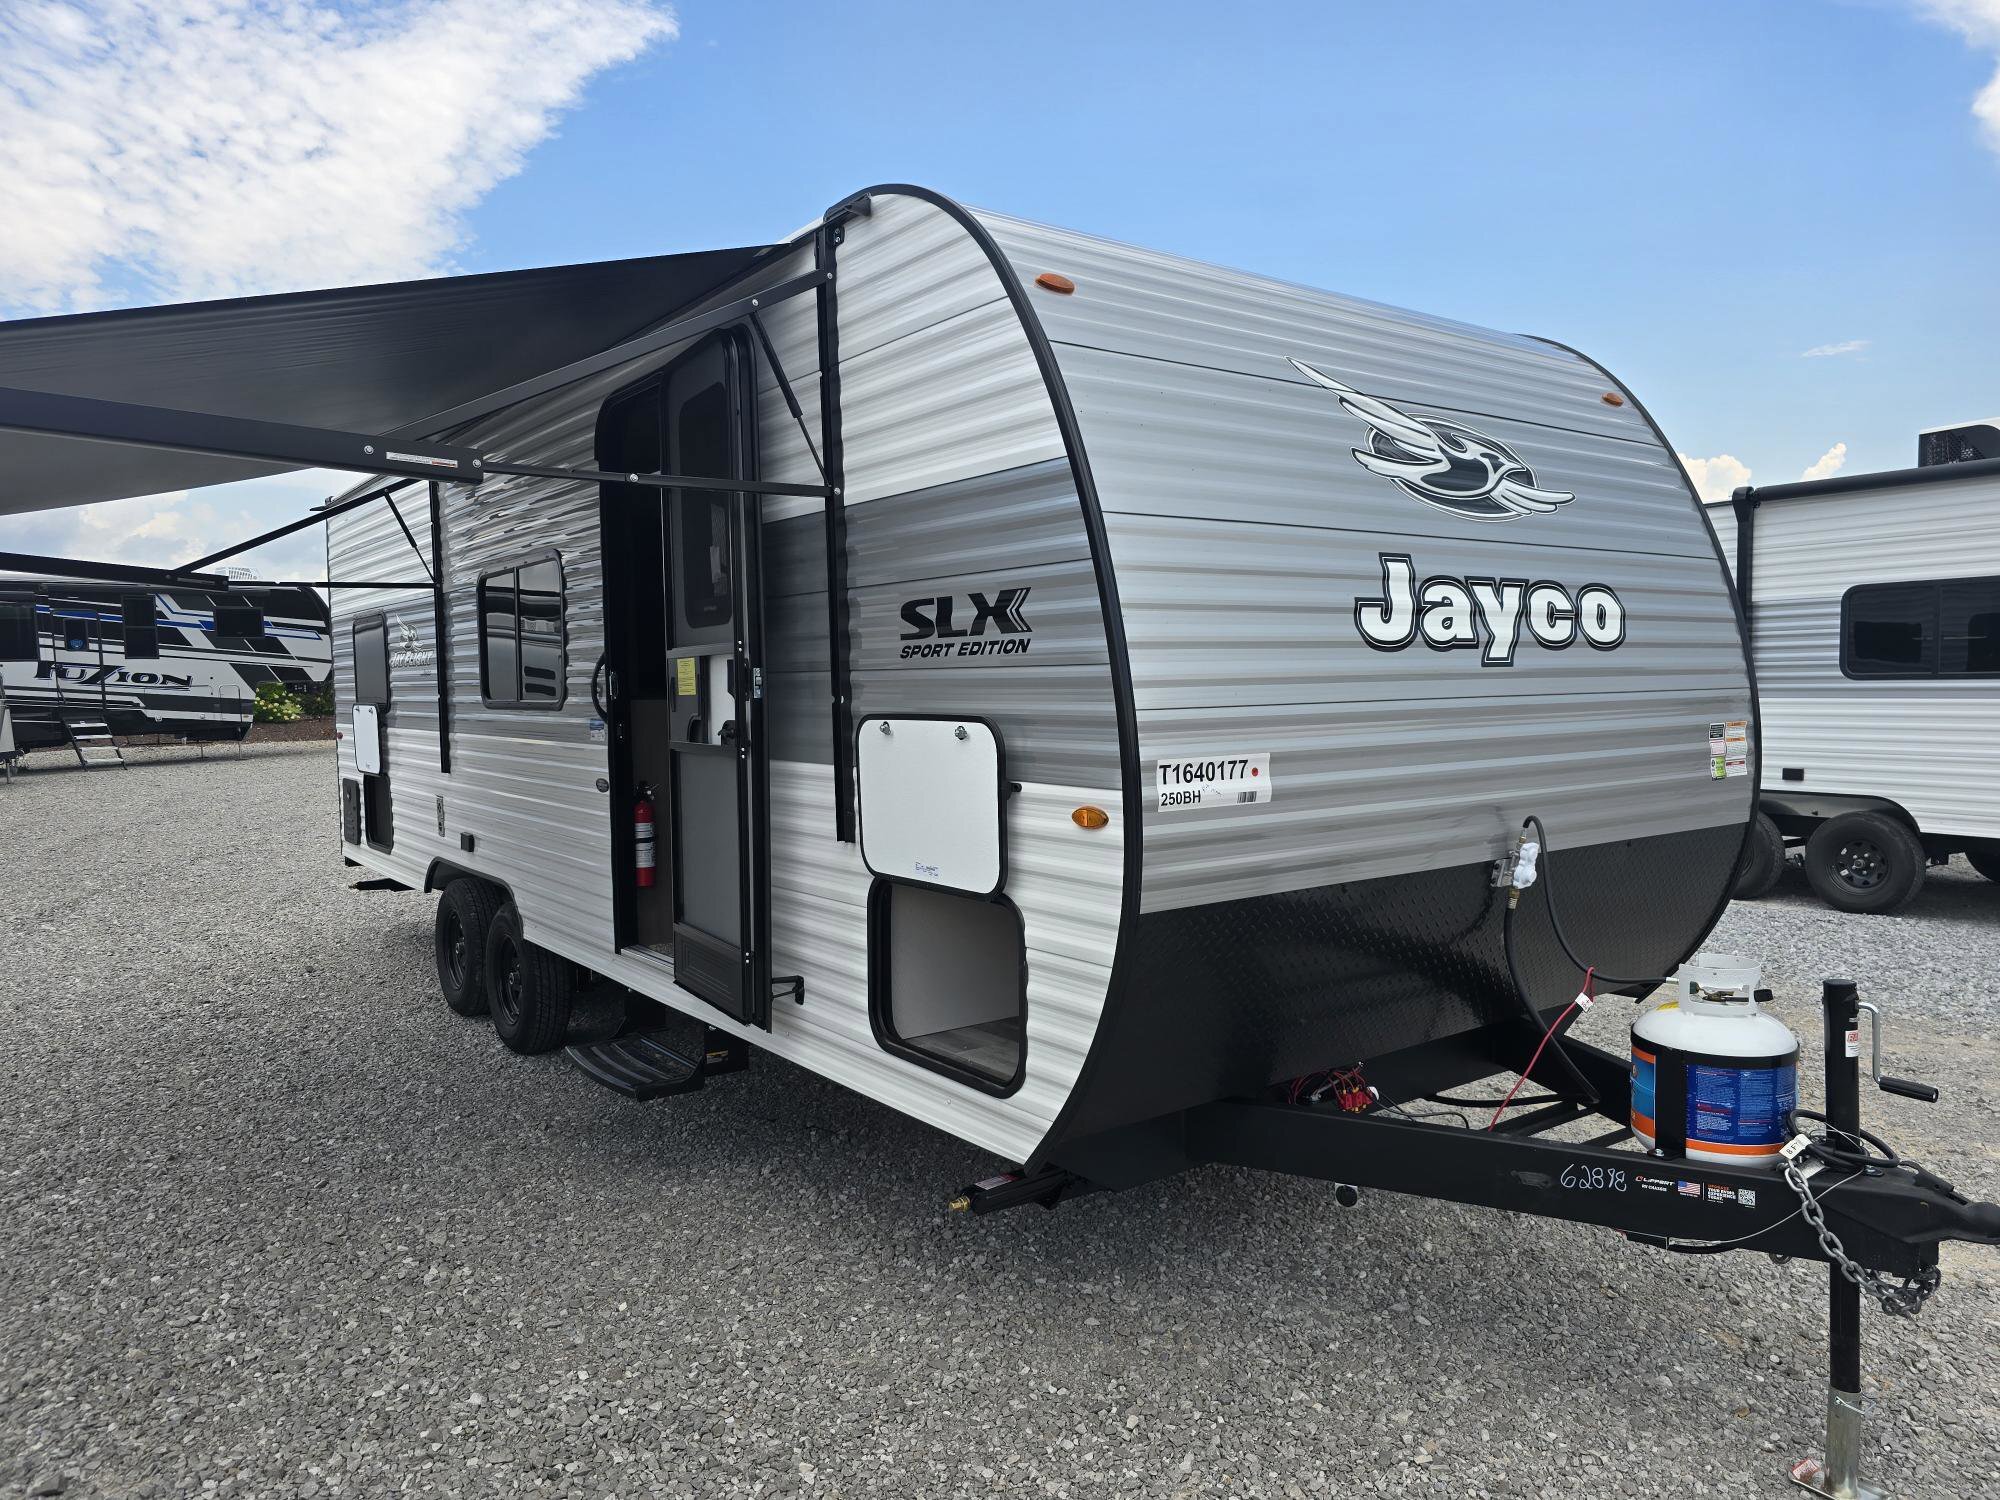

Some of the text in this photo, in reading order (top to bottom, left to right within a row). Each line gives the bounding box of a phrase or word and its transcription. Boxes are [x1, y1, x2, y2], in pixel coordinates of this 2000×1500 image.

[900, 587, 1032, 640] SLX
[1354, 552, 1626, 667] Jayco
[900, 638, 1031, 659] SPORT EDITION
[1159, 760, 1248, 785] T1640177
[1161, 790, 1201, 806] 250BH
